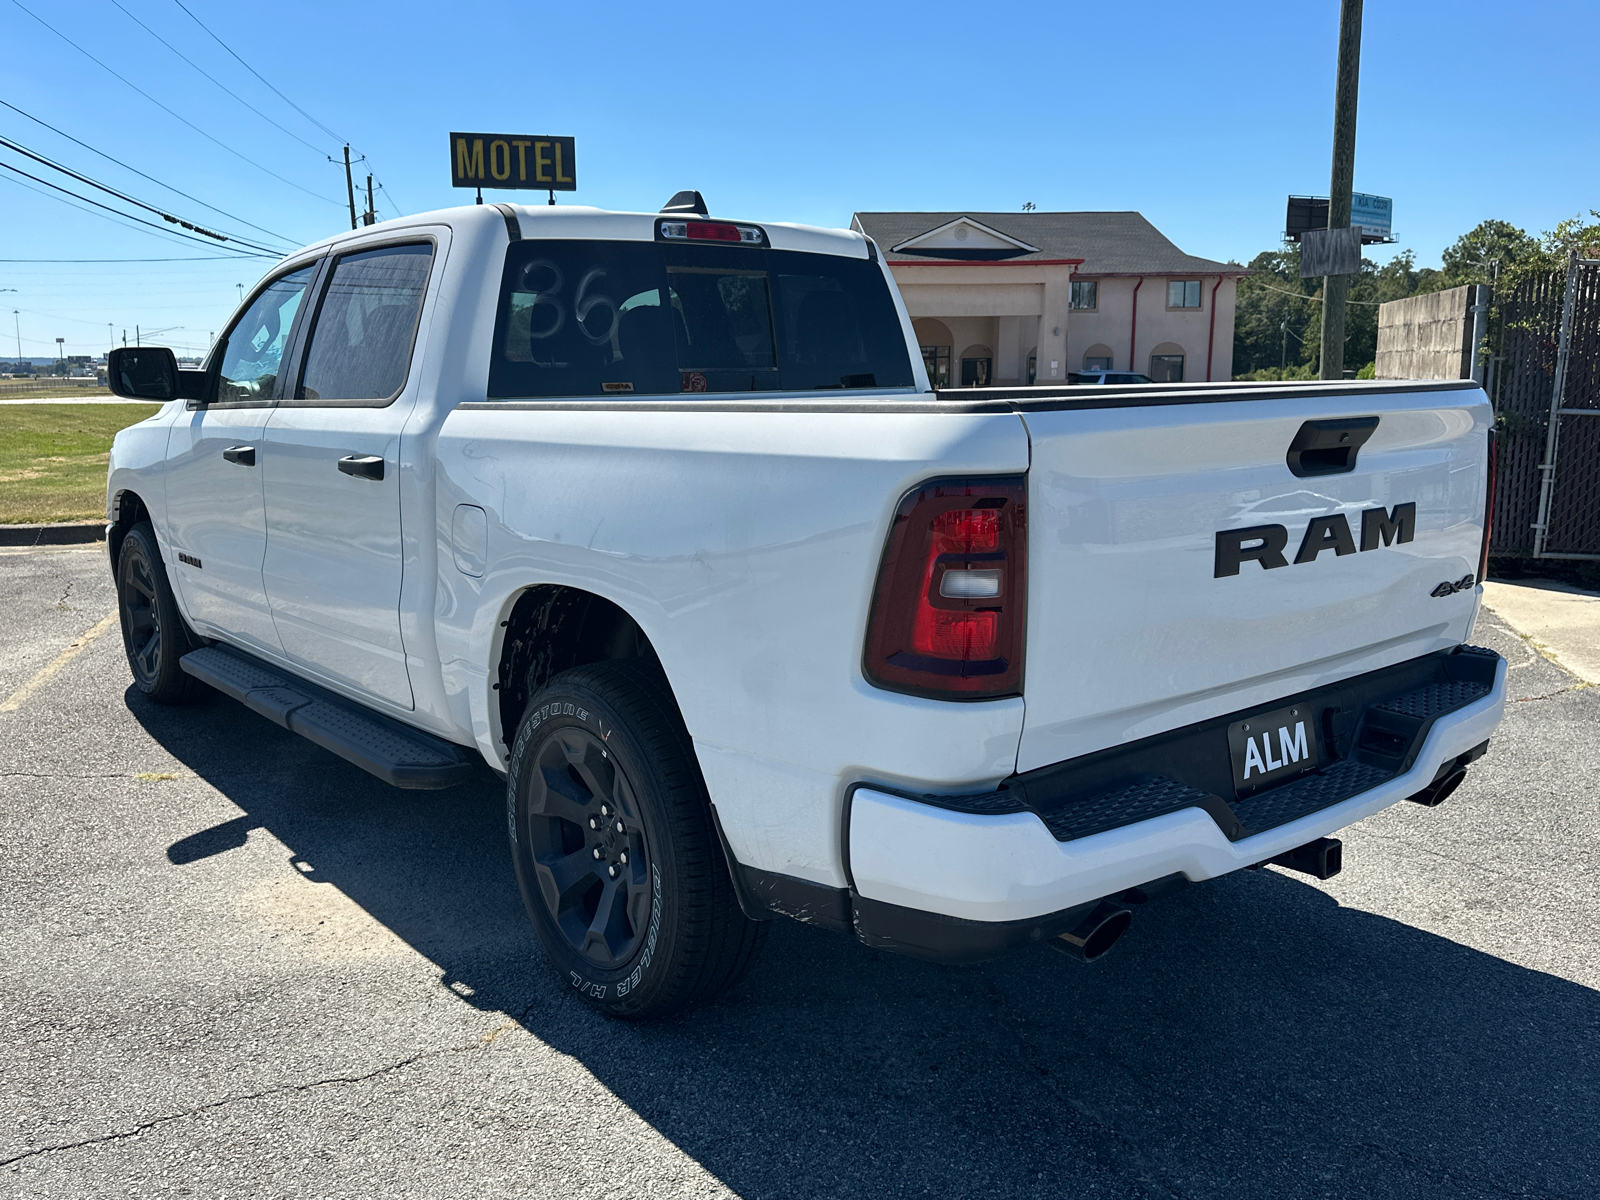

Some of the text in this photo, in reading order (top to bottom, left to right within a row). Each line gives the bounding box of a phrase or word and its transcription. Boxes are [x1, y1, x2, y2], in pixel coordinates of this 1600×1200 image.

[456, 138, 573, 183] MOTEL
[1358, 197, 1369, 208] KIA
[178, 552, 203, 569] RAM
[1214, 502, 1416, 579] RAM
[508, 702, 589, 843] BRIDGESTONE
[1243, 721, 1309, 780] ALM
[570, 862, 662, 999] DUELER H/L
